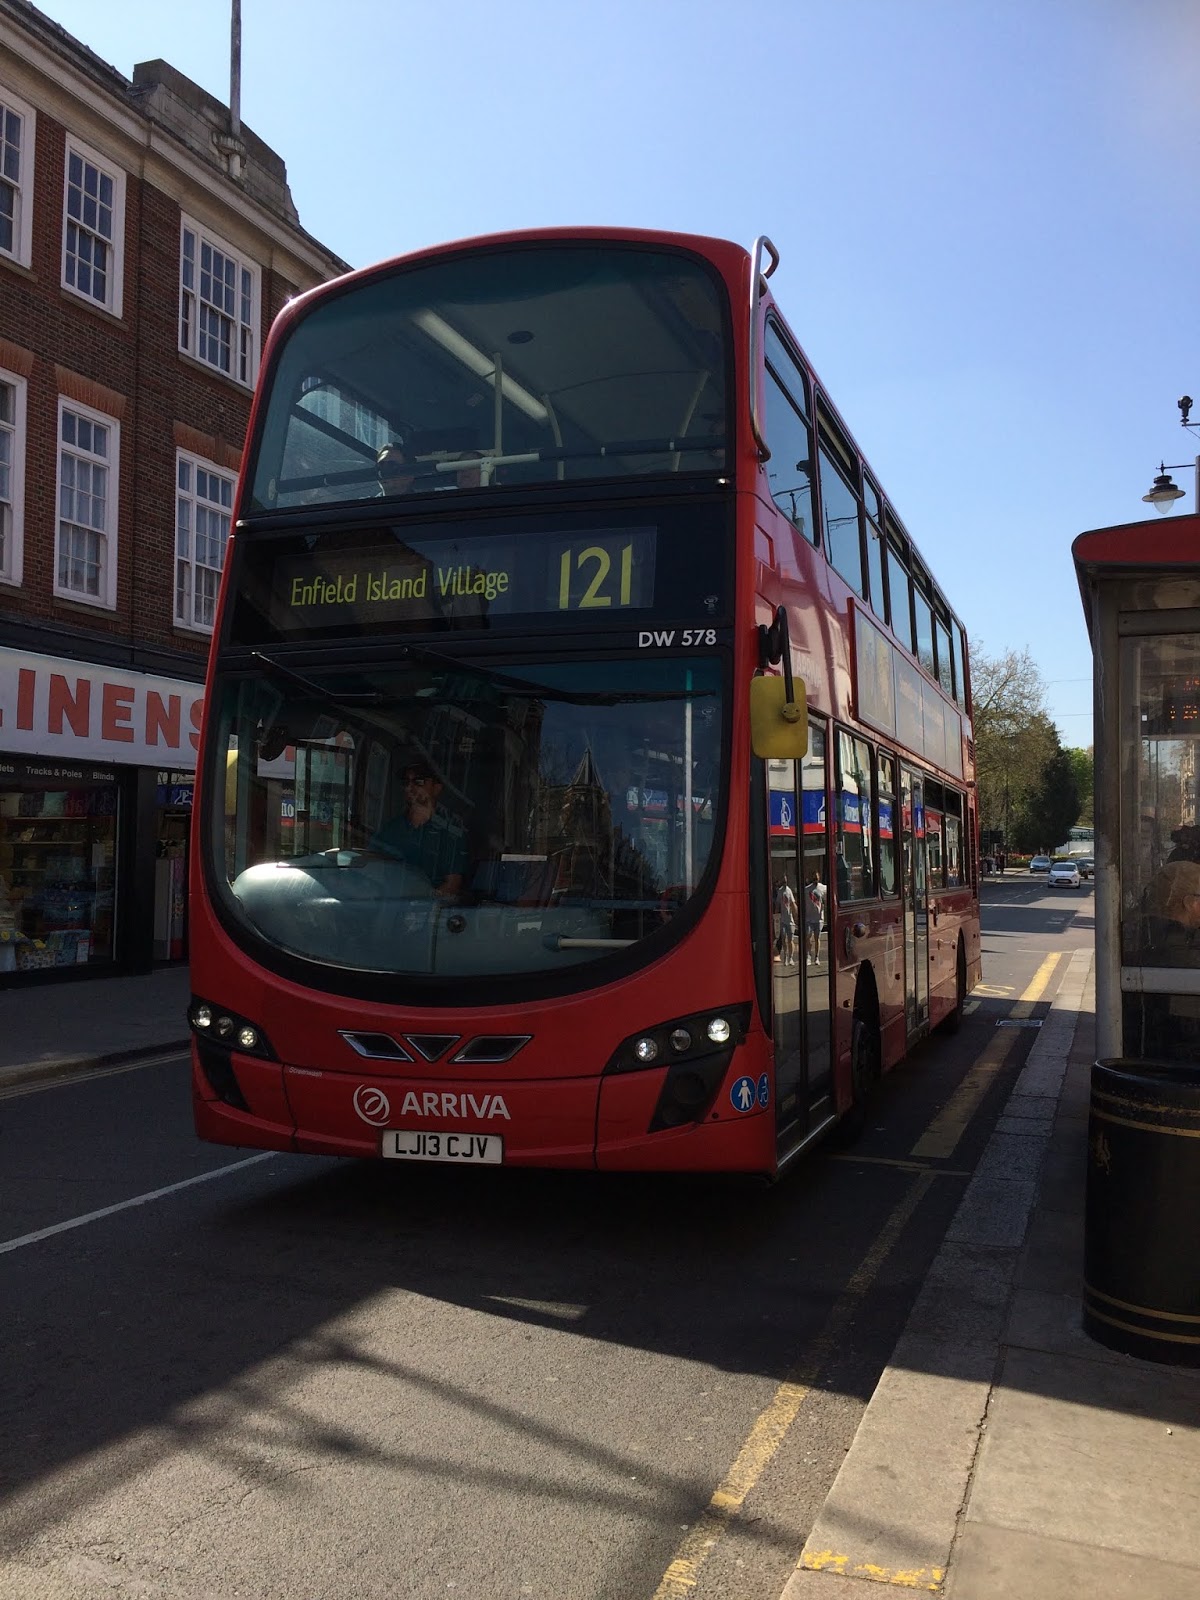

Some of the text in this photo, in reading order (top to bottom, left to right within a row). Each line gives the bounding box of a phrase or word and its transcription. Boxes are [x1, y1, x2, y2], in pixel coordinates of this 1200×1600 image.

[290, 567, 509, 607] Enfield Island Village
[559, 543, 632, 610] 121
[638, 629, 717, 648] DW 578
[26, 766, 52, 776] Tracks
[54, 769, 60, 777] &
[62, 769, 83, 779] Poles
[92, 771, 115, 781] Blinds
[401, 1092, 511, 1120] ARRIVA
[395, 1133, 488, 1158] LJ13 CJV
